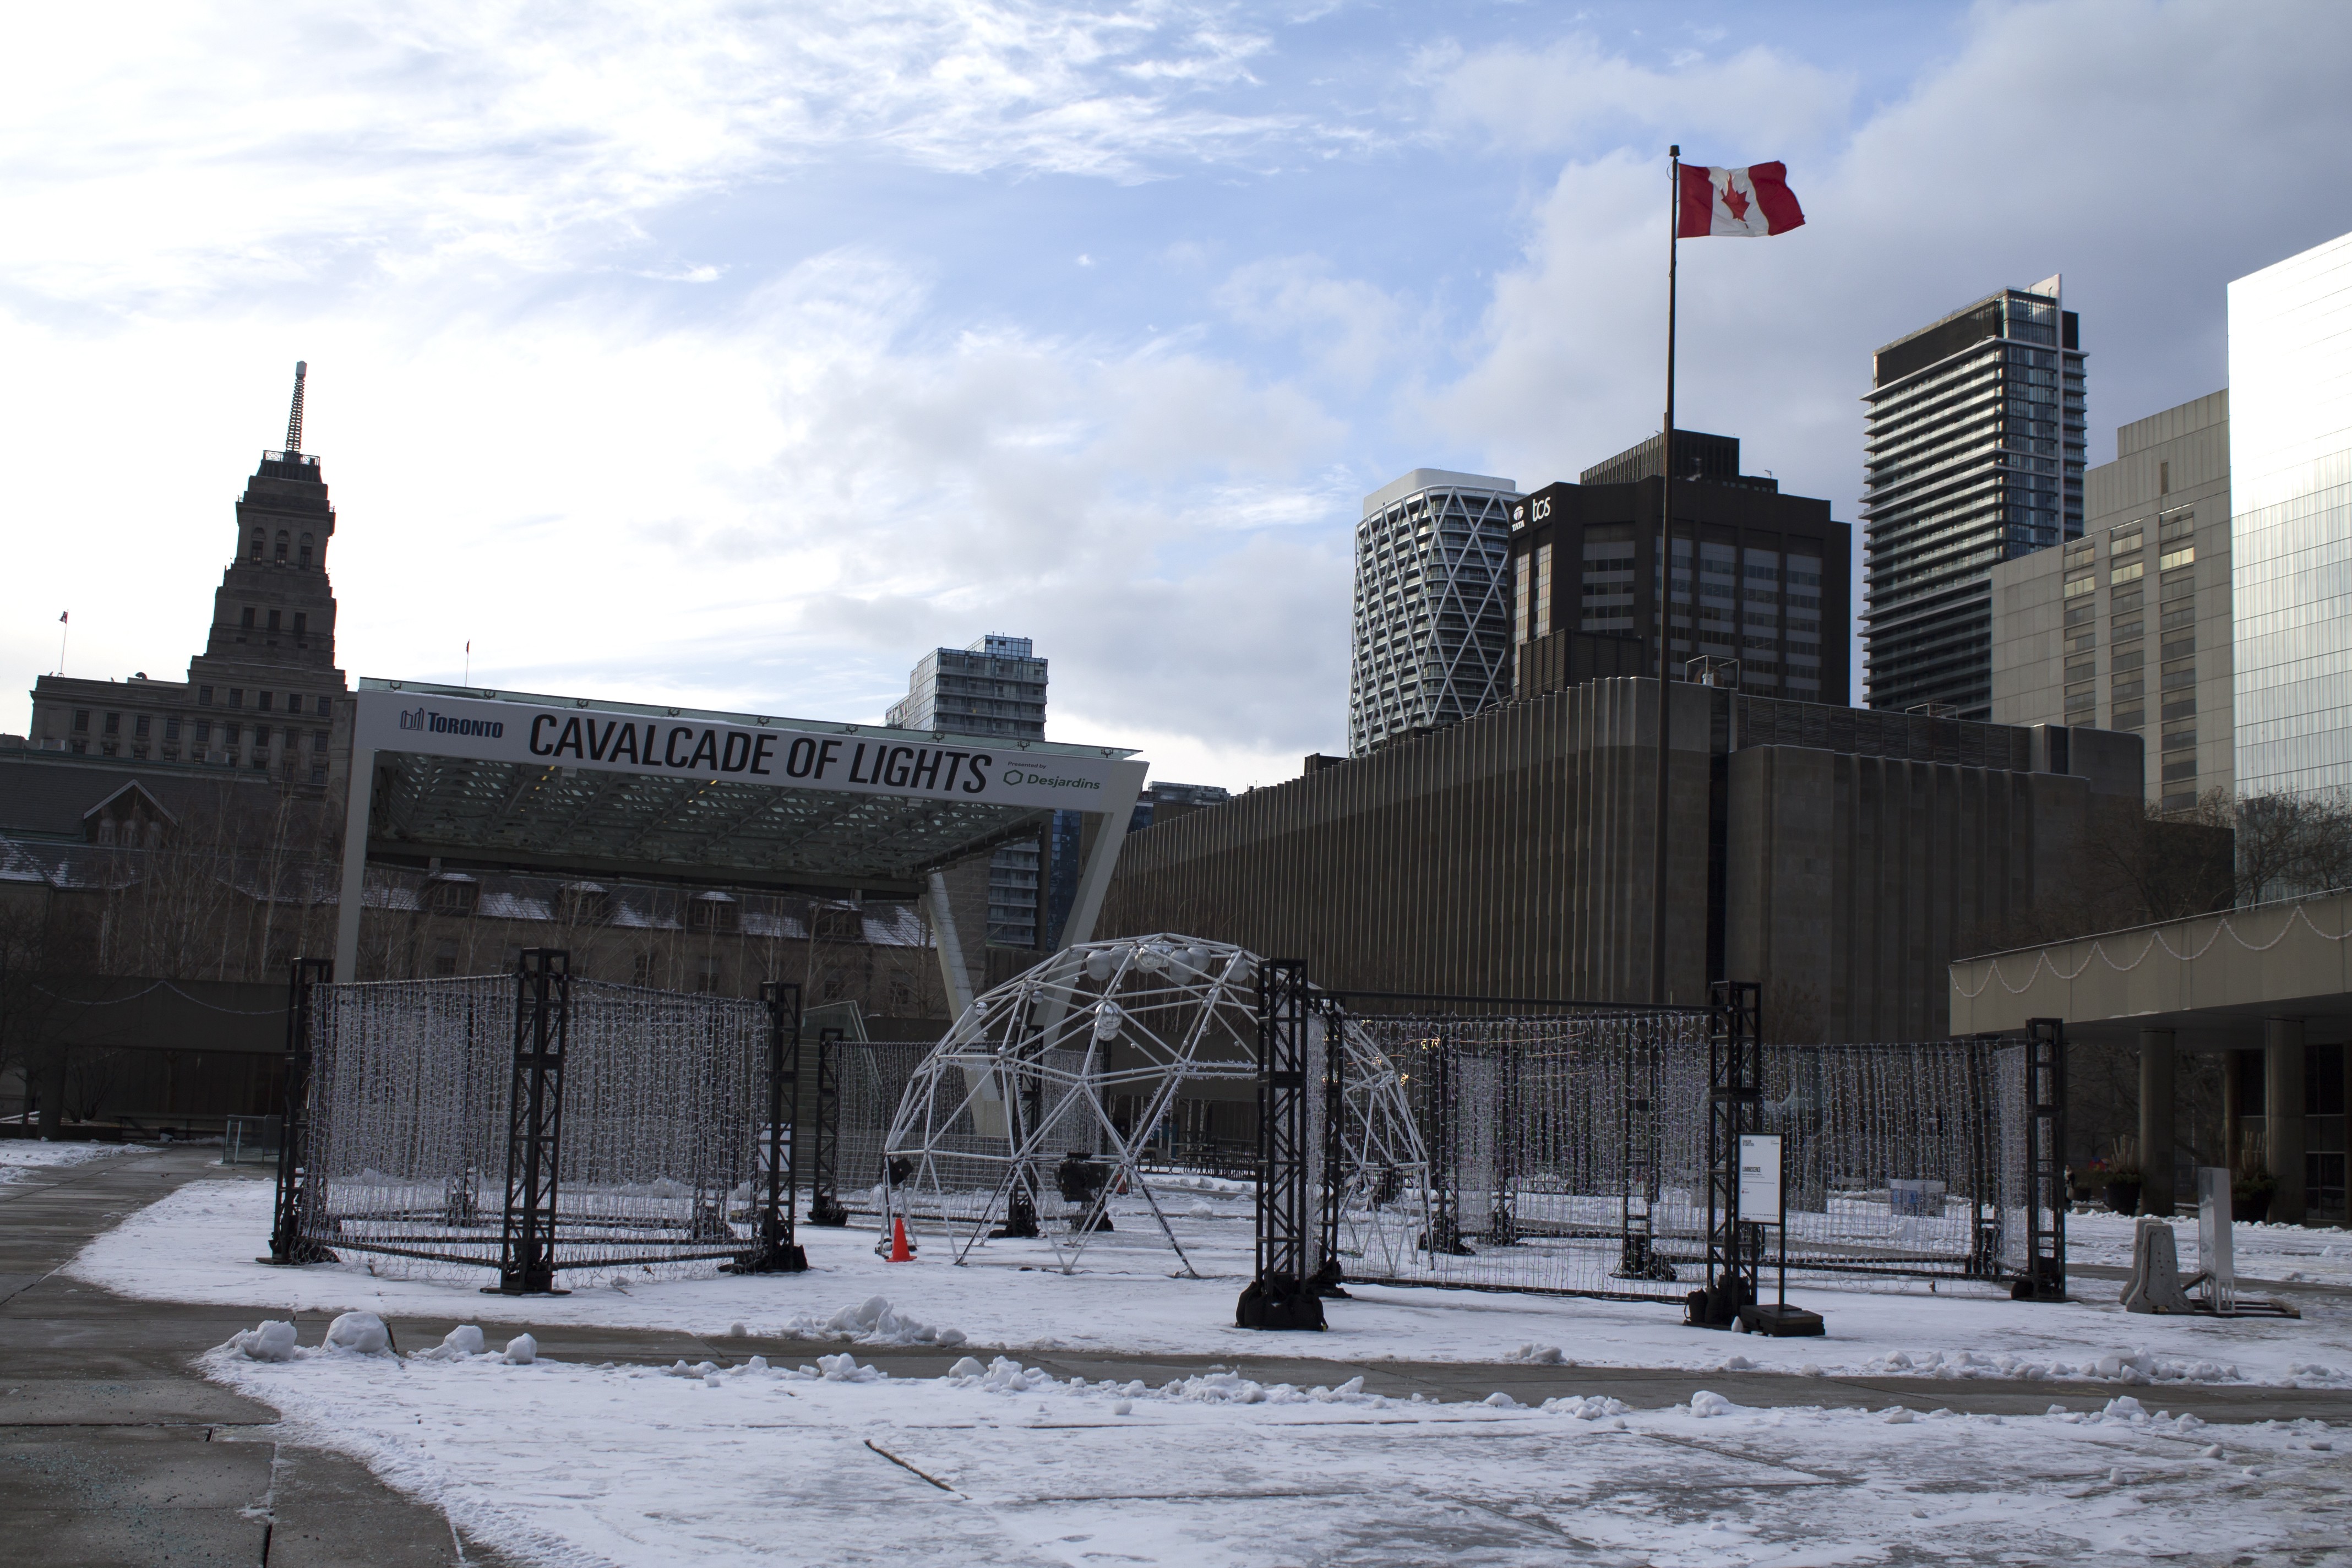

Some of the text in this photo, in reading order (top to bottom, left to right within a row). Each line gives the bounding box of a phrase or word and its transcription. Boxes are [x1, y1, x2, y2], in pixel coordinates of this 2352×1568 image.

[1532, 497, 1551, 522] tcs
[1512, 520, 1525, 532] TATA
[428, 712, 504, 738] TORONTO
[529, 714, 993, 794] CAVALCADE OF LIGHTS
[1027, 774, 1101, 790] Desjardins
